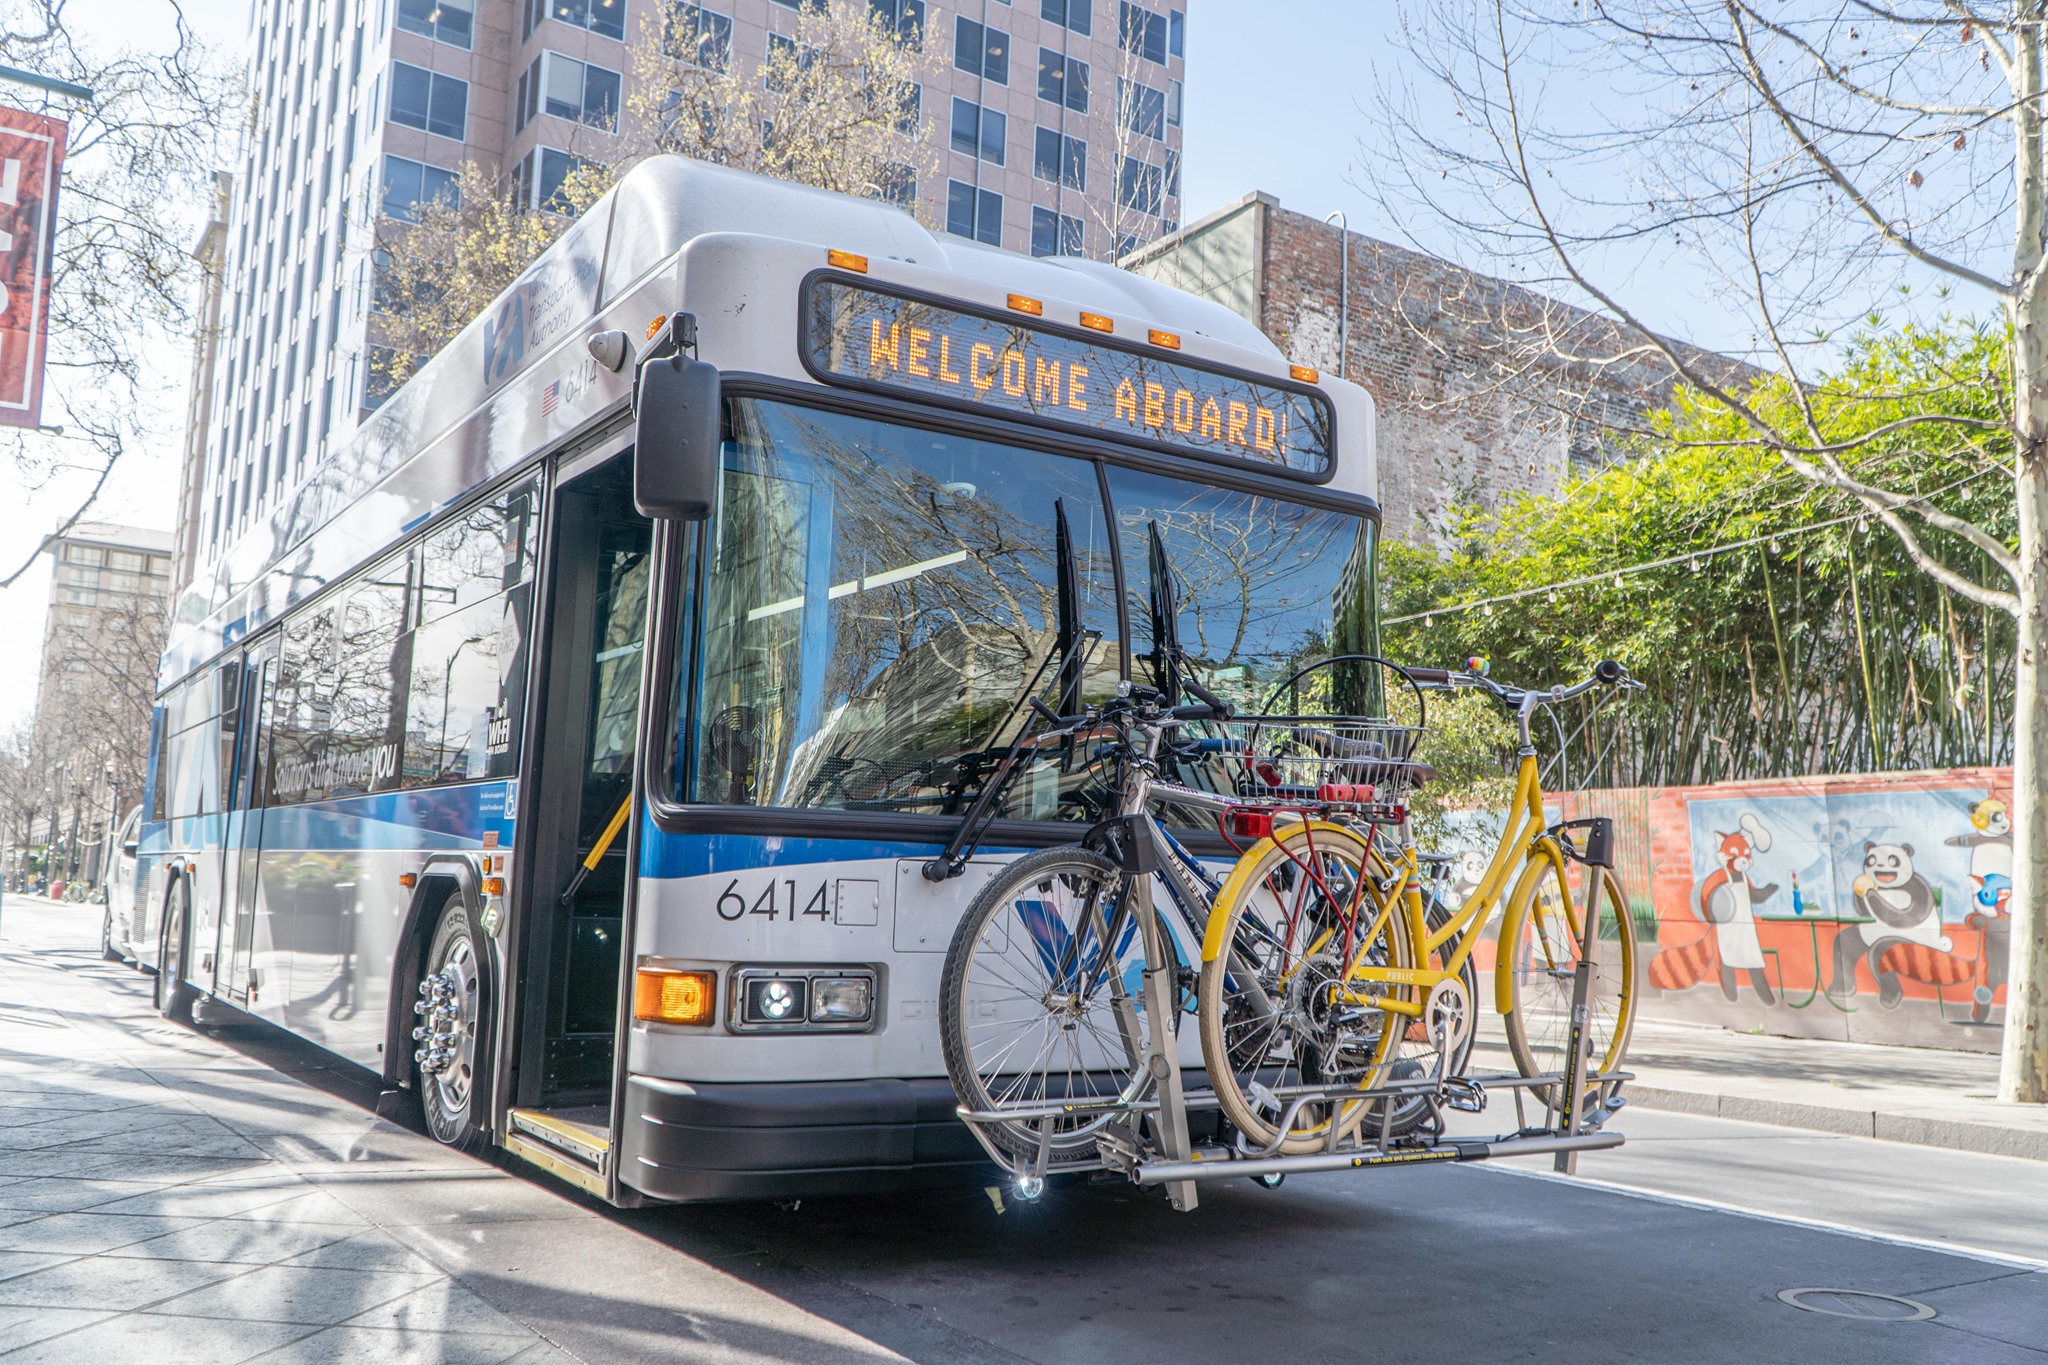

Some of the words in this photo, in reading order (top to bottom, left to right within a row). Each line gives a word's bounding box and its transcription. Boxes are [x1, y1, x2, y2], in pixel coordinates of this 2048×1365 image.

[528, 257, 597, 327] Transportation
[528, 303, 575, 352] Authority
[565, 359, 598, 403] 6414
[869, 318, 1089, 411] WELCOME
[1114, 376, 1288, 455] ABOARD!
[272, 756, 315, 796] Solutions
[314, 749, 336, 788] that
[336, 750, 371, 787] move
[367, 743, 398, 793] you
[716, 878, 831, 922] 6414
[1387, 970, 1415, 981] PUBLIC
[1403, 1154, 1422, 1162] squeeze
[1422, 1152, 1438, 1160] handle
